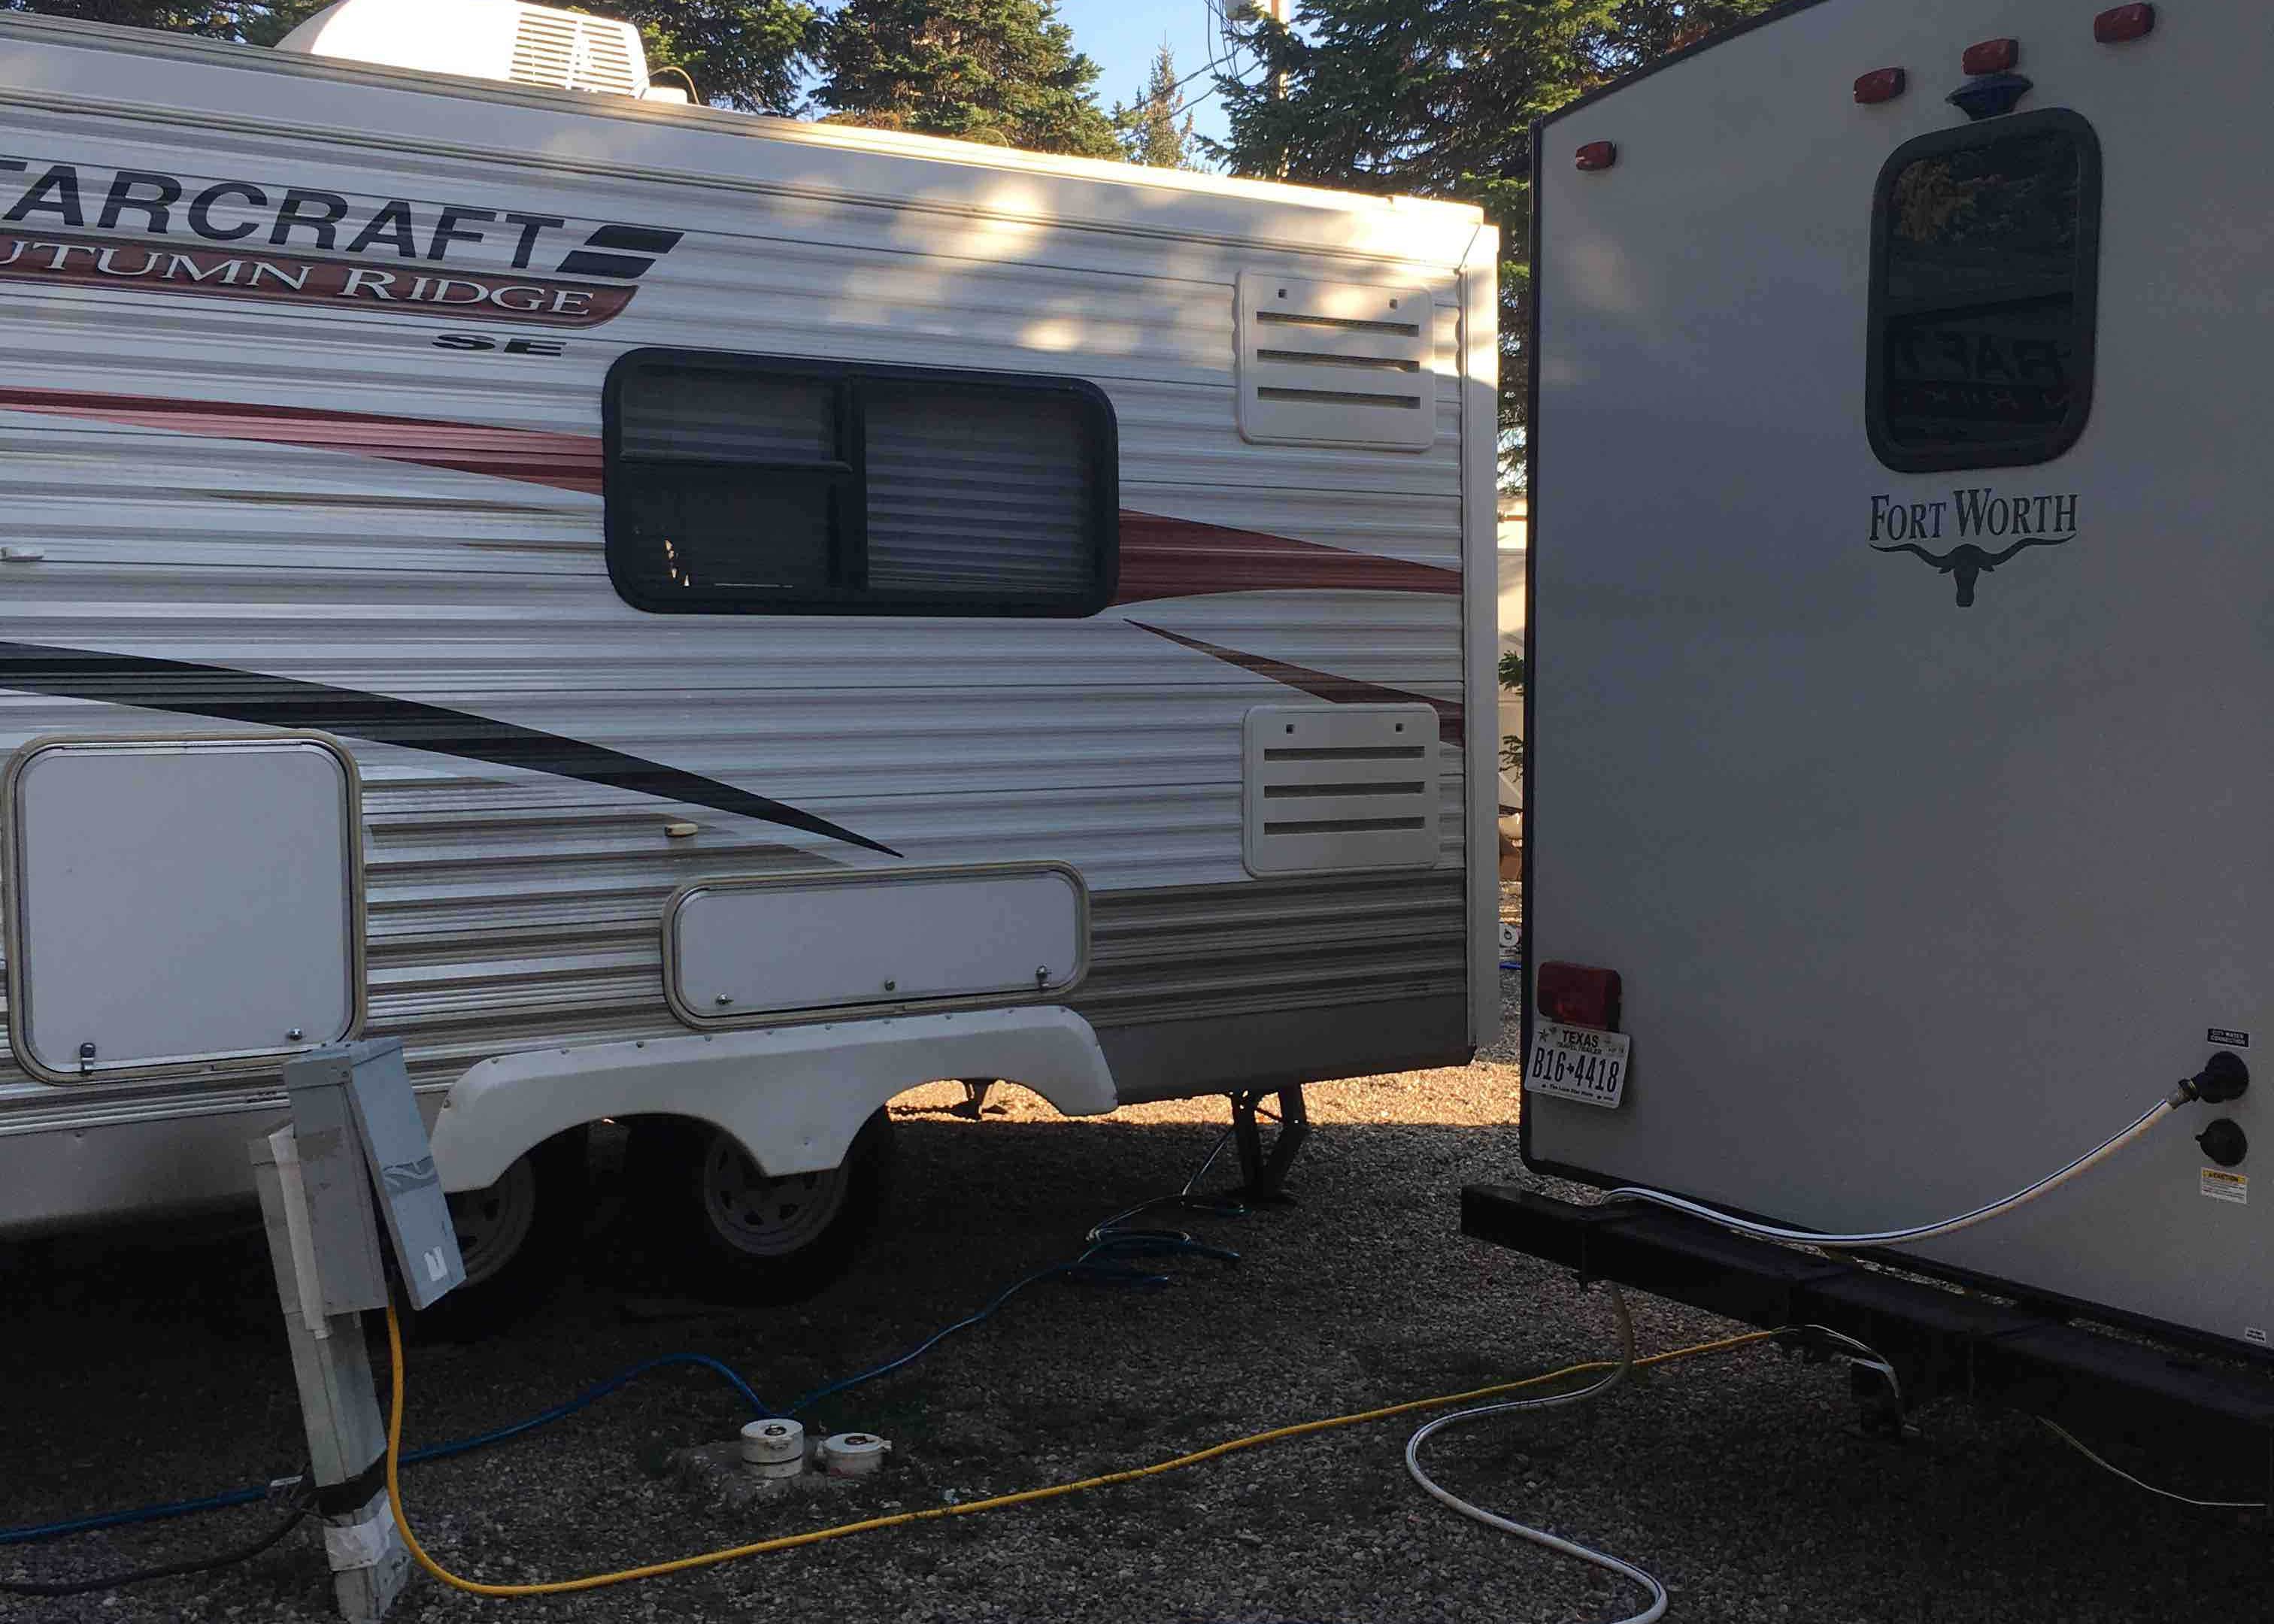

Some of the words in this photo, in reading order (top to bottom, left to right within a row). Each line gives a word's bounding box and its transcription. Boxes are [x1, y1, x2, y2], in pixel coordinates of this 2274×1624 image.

[338, 267, 594, 316] RIDGE
[432, 334, 567, 357] SE
[1869, 494, 1946, 541] FORT
[1953, 488, 2081, 537] WORTH
[1563, 1030, 1599, 1048] TEXAS
